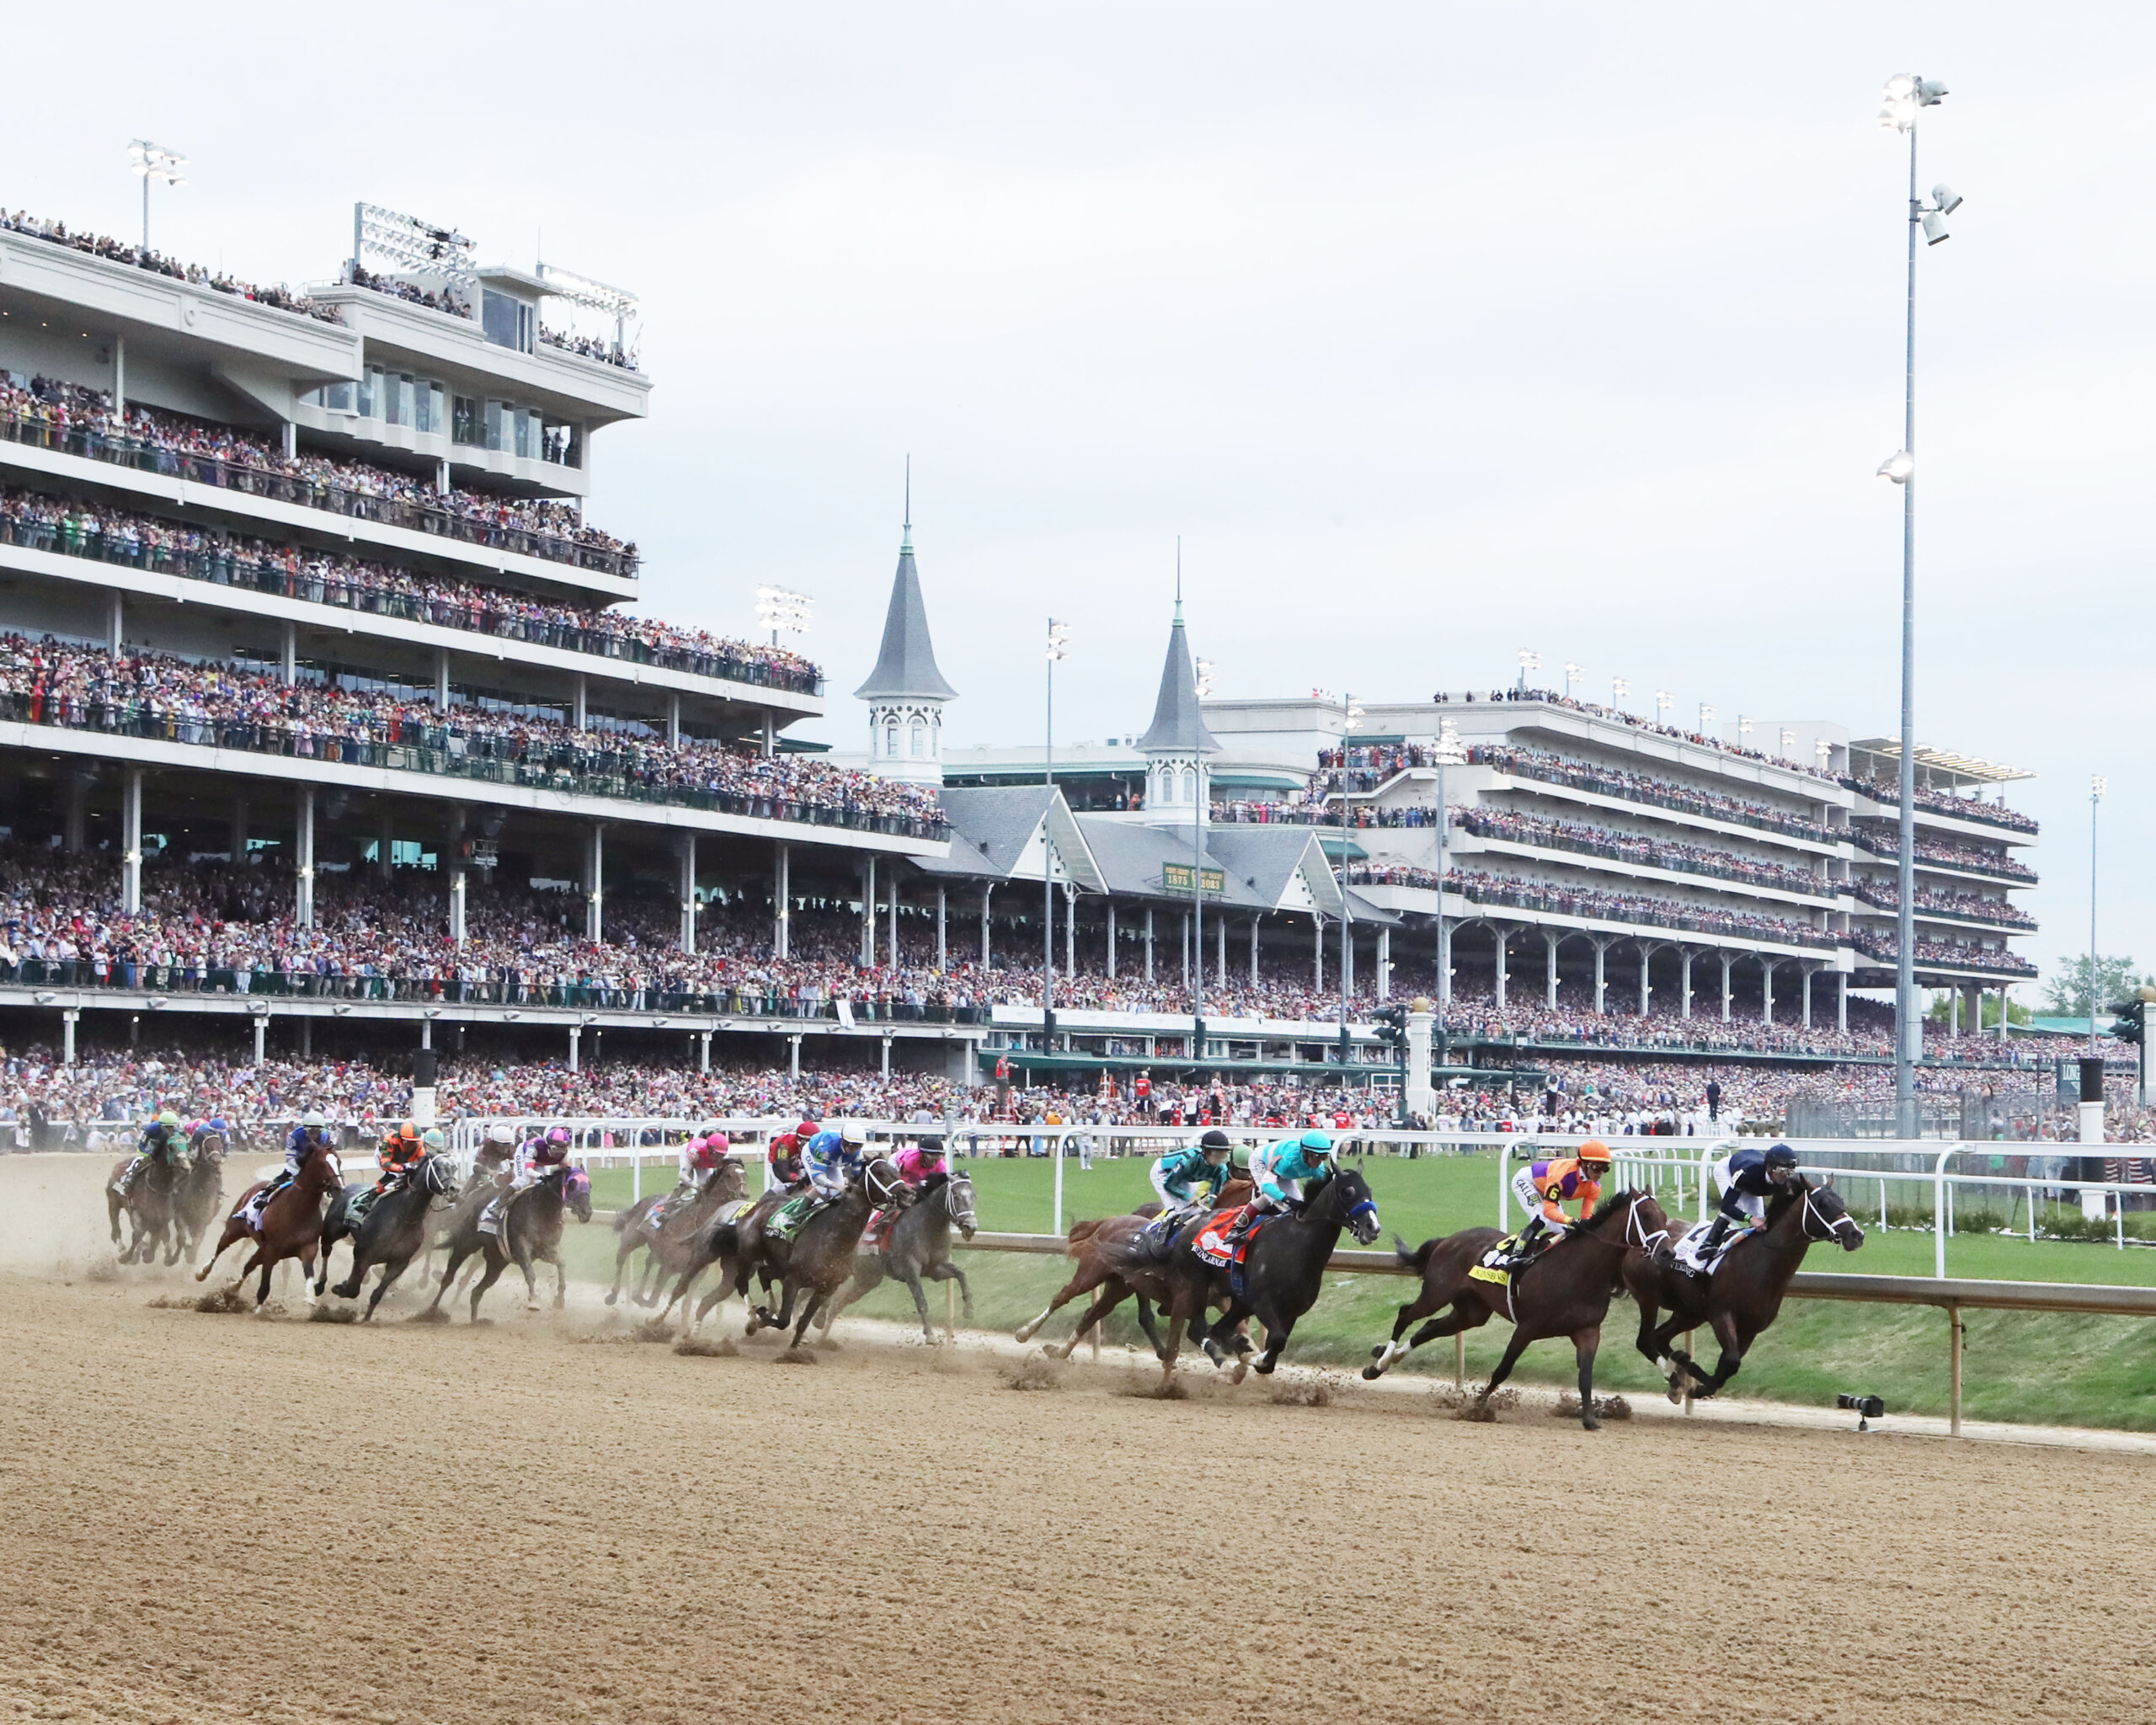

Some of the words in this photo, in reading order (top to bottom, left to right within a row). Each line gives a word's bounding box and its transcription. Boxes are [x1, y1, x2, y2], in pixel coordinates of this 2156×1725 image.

[1168, 875, 1188, 885] 1875
[1201, 879, 1219, 889] 2023
[777, 1148, 788, 1160] 18
[1517, 1179, 1532, 1197] CALL
[1549, 1188, 1560, 1200] 6
